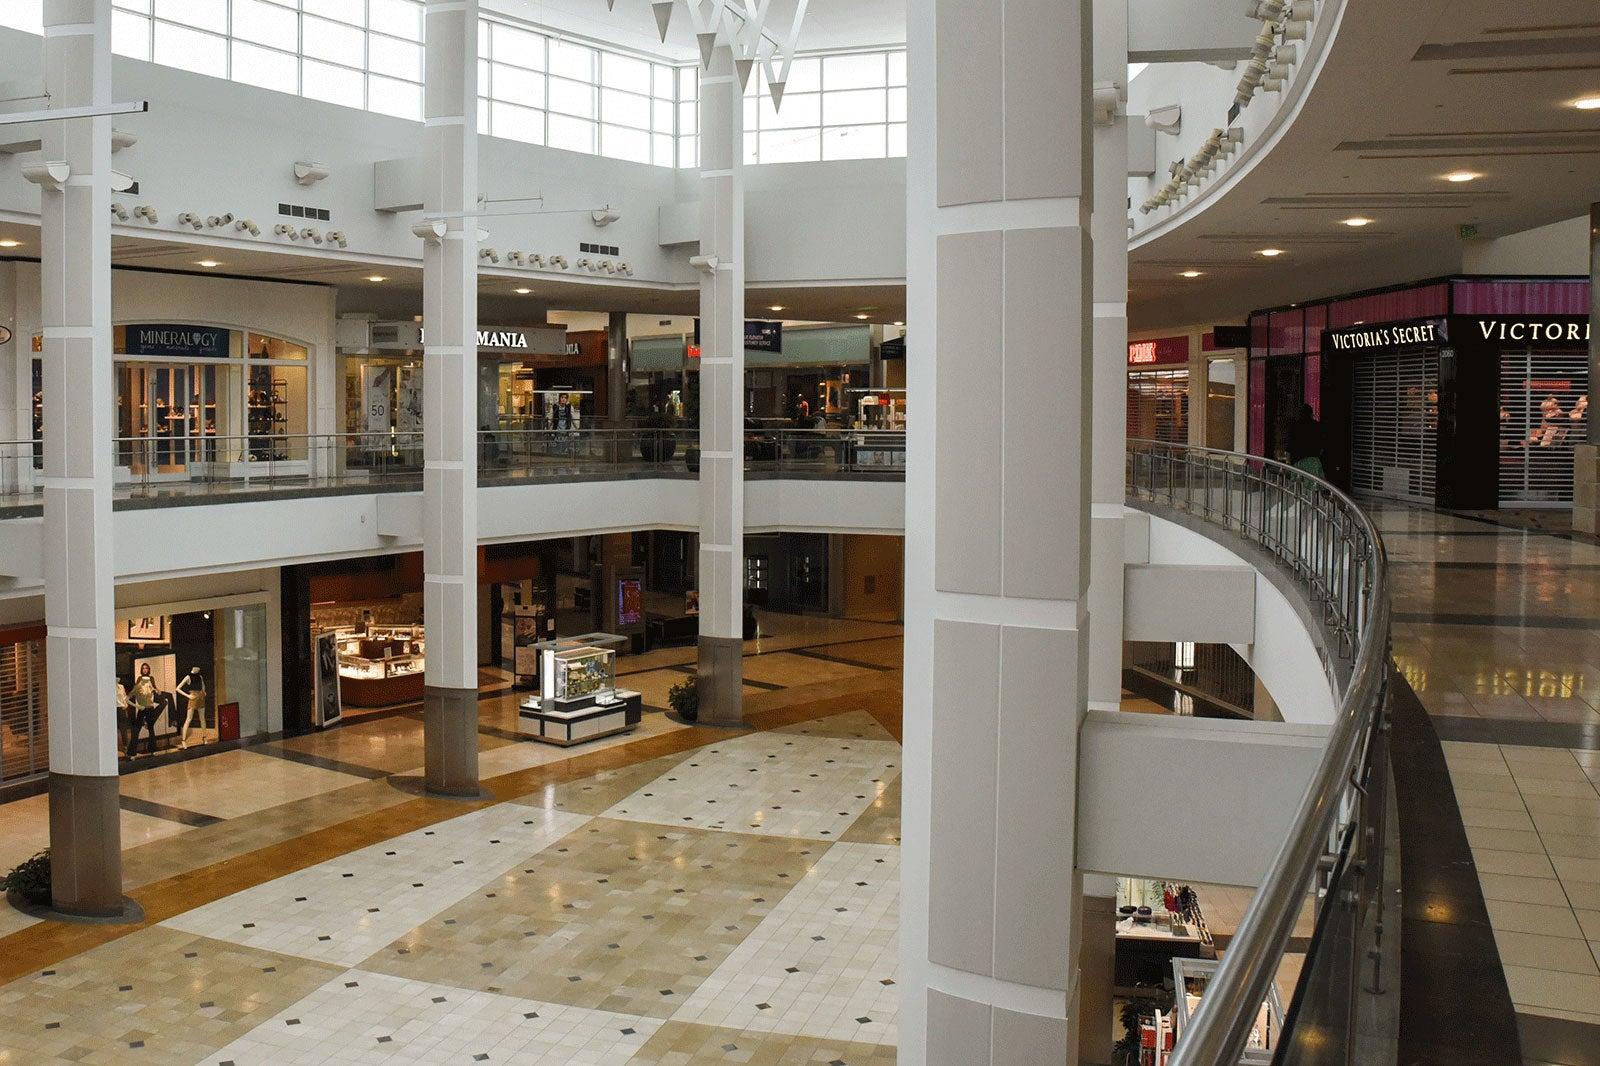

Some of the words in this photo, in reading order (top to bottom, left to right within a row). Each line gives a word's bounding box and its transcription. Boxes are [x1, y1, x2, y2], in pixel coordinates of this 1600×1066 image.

[1331, 329, 1390, 349] VICTORIA'S
[1392, 324, 1434, 345] SECRET
[371, 404, 385, 416] 50
